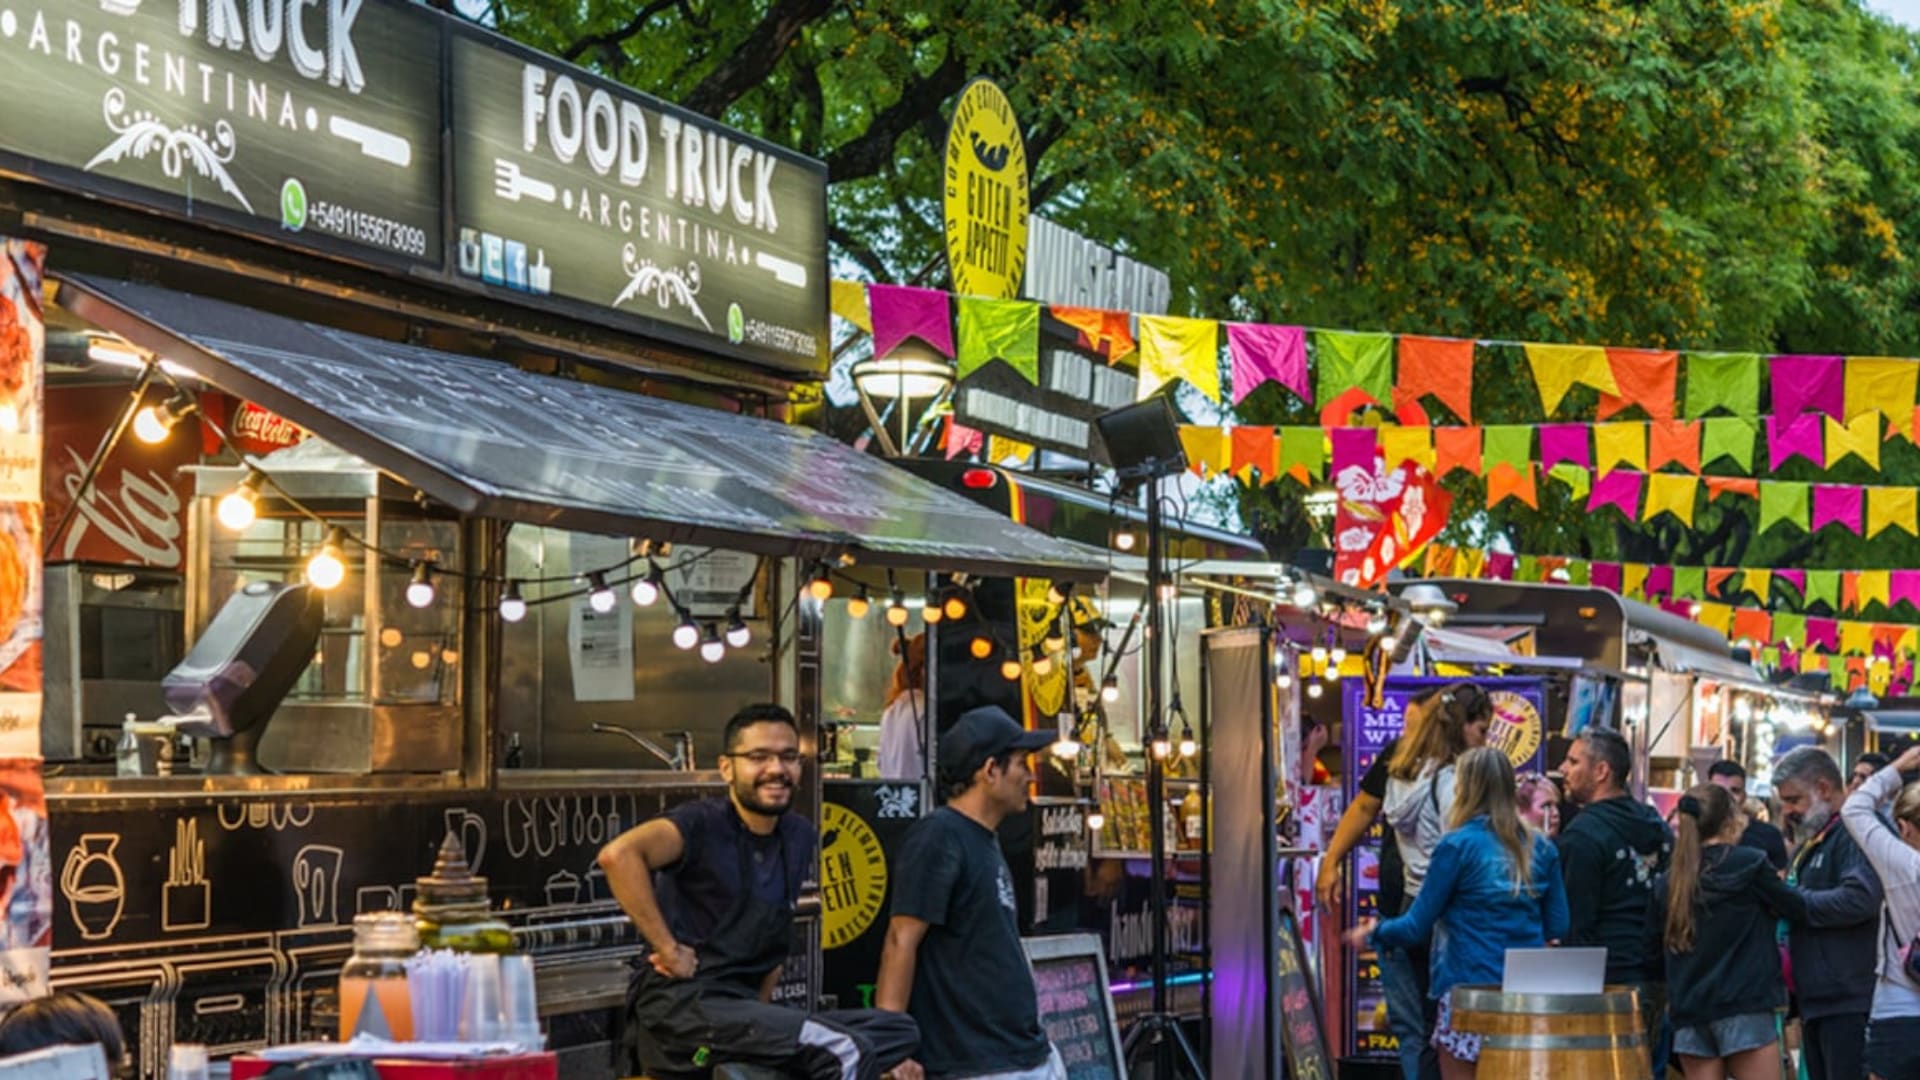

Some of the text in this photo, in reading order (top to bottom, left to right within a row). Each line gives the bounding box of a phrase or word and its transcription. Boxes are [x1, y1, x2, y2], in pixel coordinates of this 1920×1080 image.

[28, 10, 298, 131] ARGENTINA
[521, 63, 780, 234] FOOD TRUCK
[308, 199, 426, 256] +5491155673099
[578, 187, 738, 266] ARGENTINA
[966, 170, 1011, 231] GUTEN
[964, 218, 1009, 277] APPETIT
